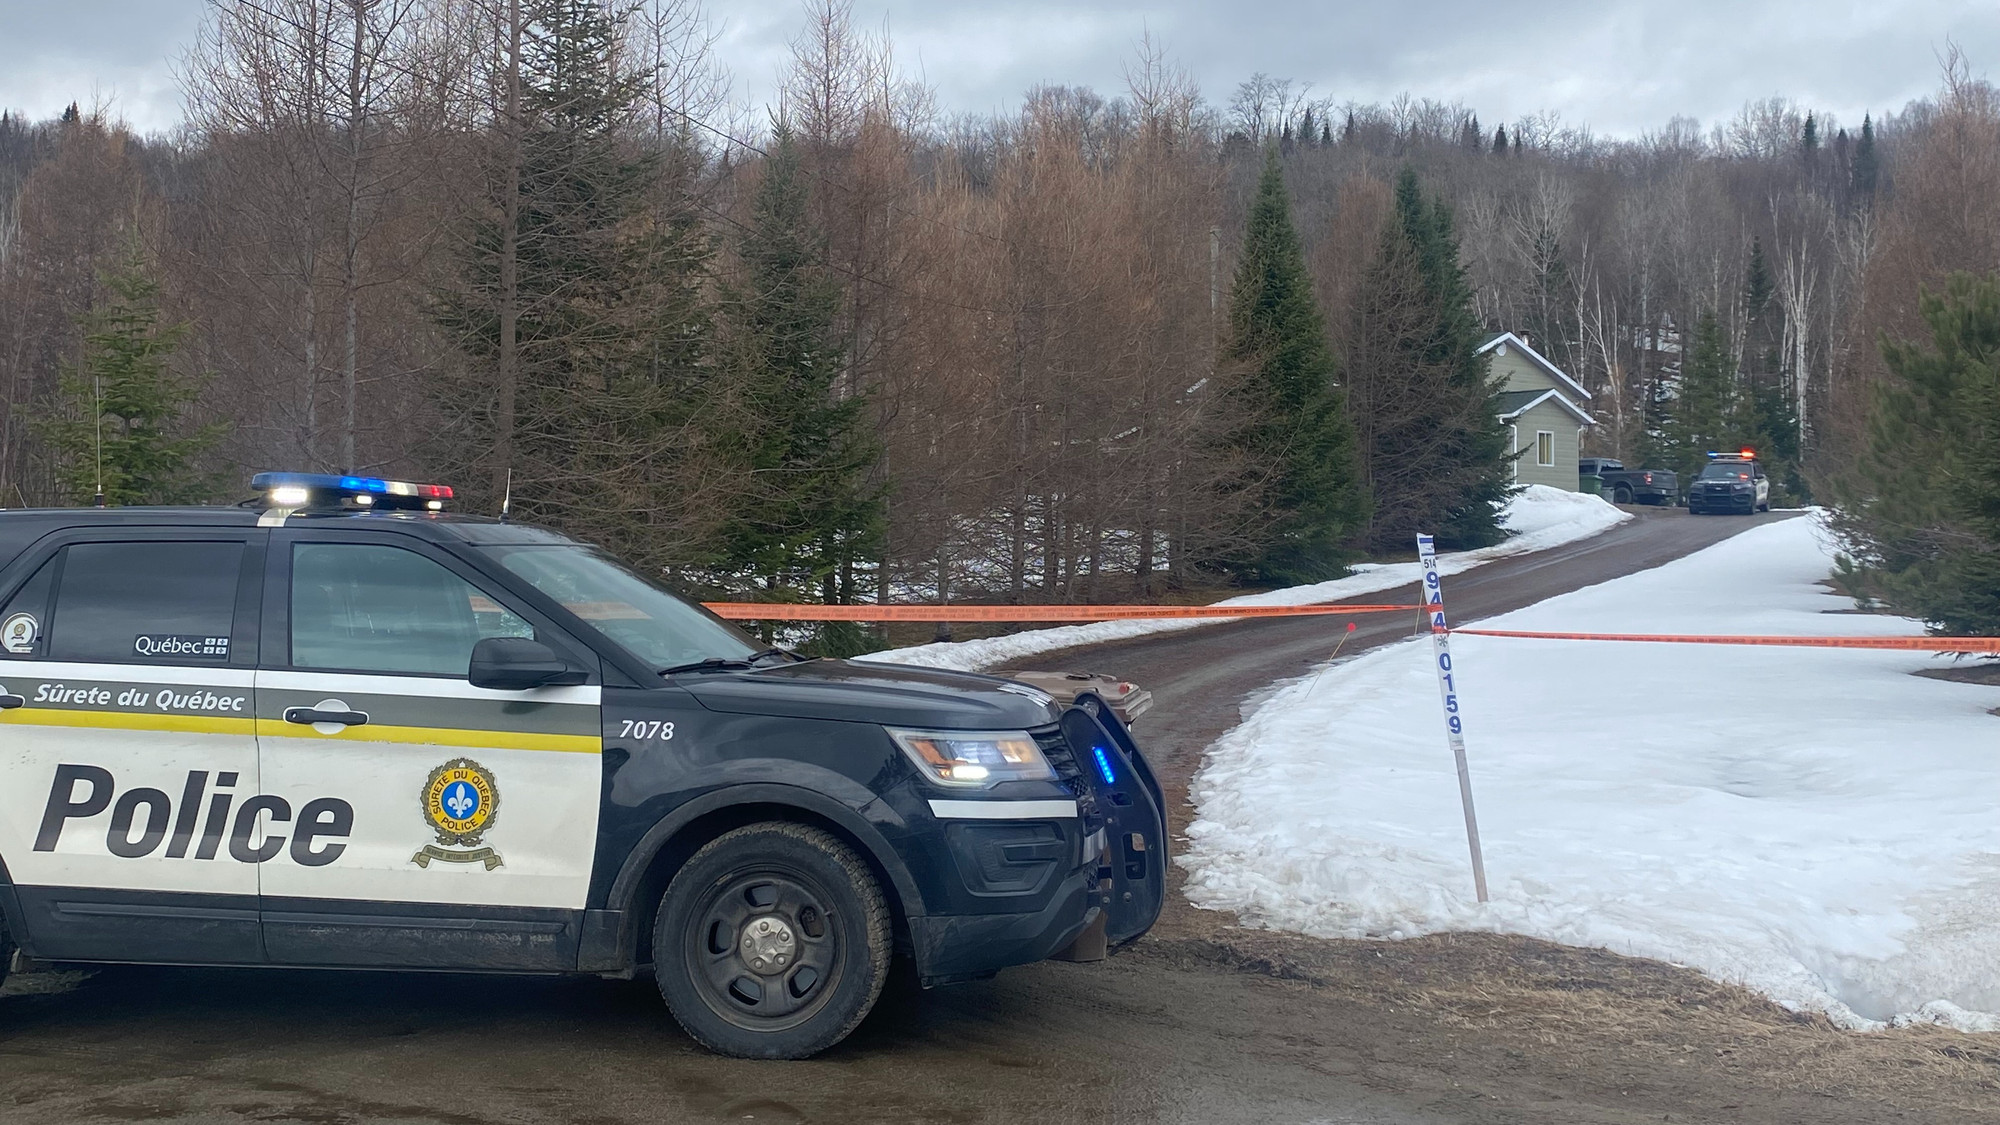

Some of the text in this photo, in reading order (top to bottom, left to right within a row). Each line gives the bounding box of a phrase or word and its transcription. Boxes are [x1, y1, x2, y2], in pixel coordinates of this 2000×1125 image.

[1424, 558, 1436, 569] 514
[135, 636, 201, 656] Québec
[117, 688, 149, 707] du
[155, 689, 245, 712] Québec
[619, 720, 675, 740] 7078
[453, 770, 468, 780] DU
[32, 763, 355, 867] Police
[440, 817, 479, 831] POLICE
